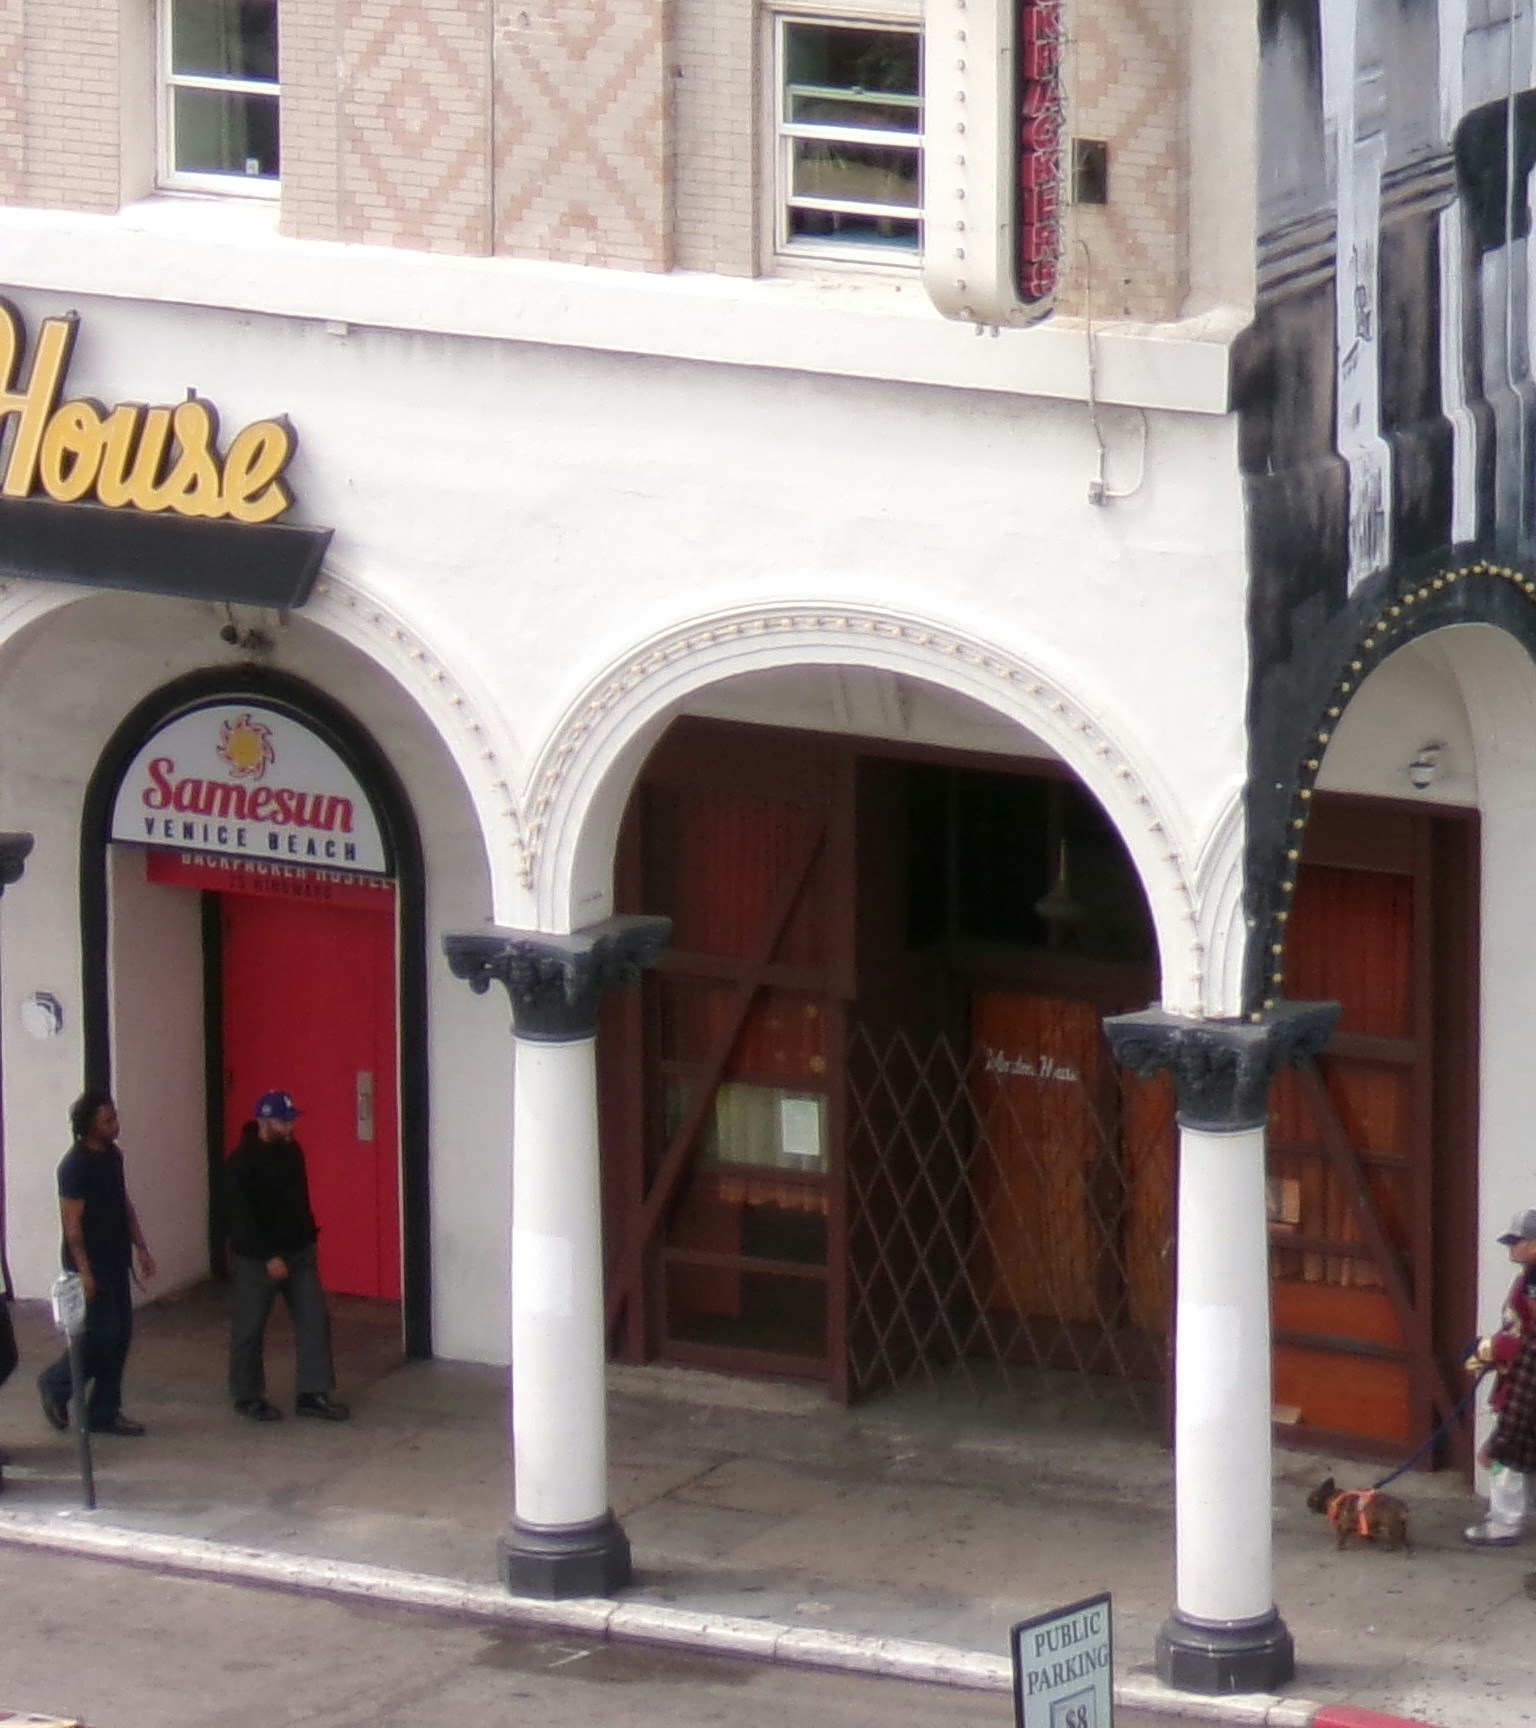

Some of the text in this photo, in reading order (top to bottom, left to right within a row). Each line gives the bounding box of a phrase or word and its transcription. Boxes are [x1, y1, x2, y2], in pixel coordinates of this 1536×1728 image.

[140, 756, 355, 834] Samesun
[144, 816, 358, 862] VENICE BEACH
[1034, 1611, 1101, 1658] PUBLIC
[1026, 1643, 1109, 1696] PARKING
